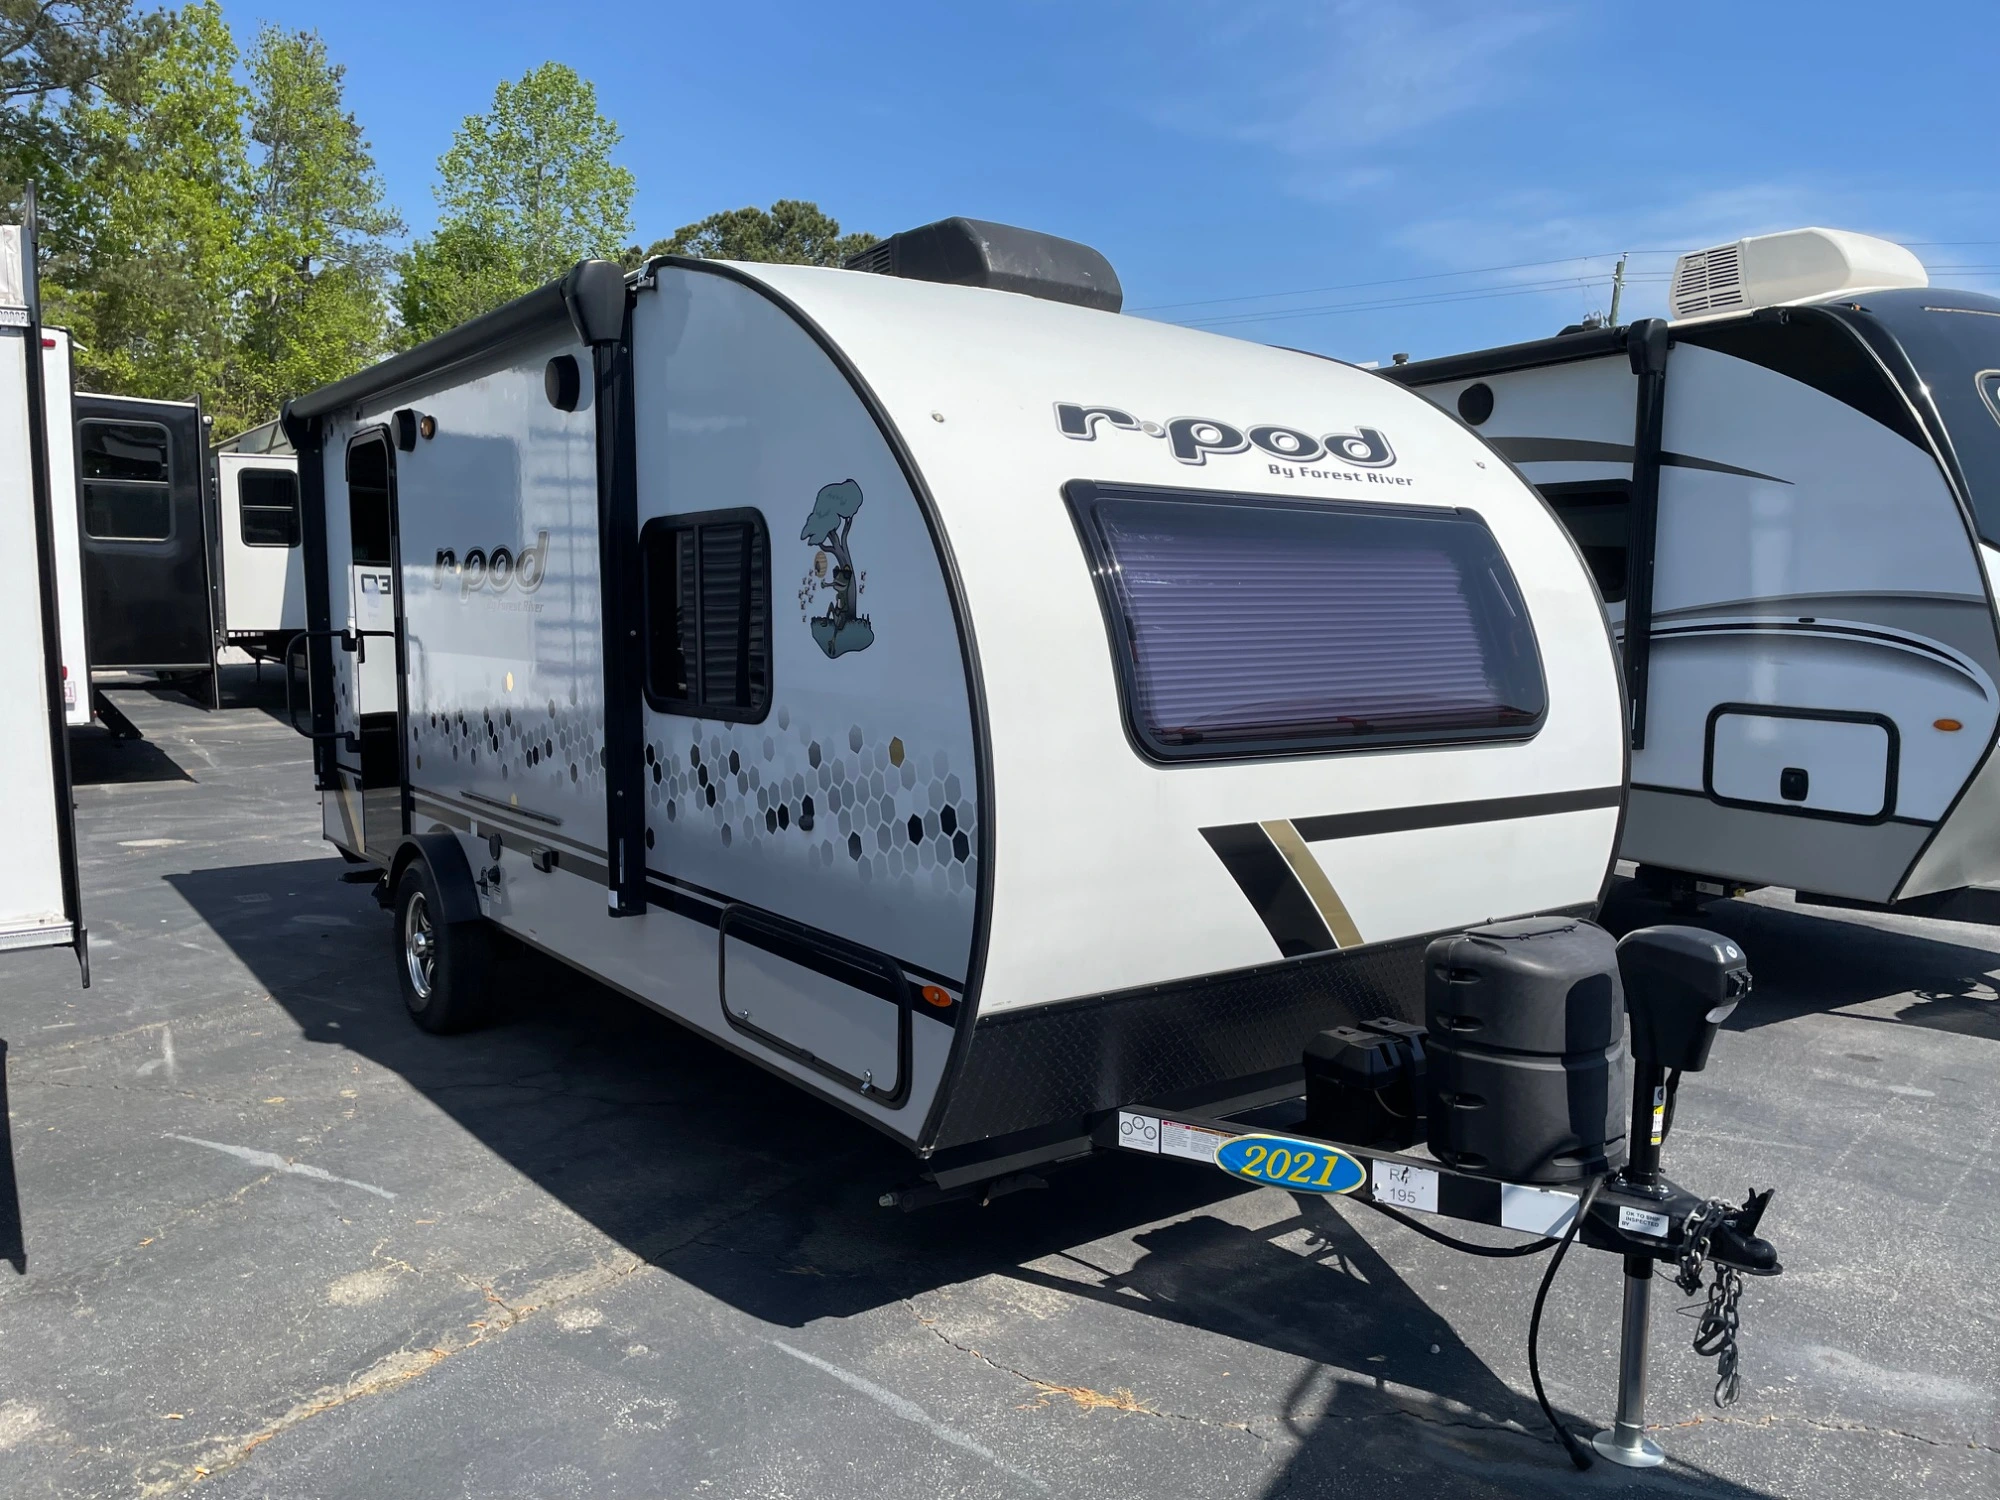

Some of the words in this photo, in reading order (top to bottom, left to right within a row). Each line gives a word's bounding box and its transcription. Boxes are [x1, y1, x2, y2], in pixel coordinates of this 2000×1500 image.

[1268, 464, 1295, 479] By
[1299, 466, 1363, 482] Forest
[1367, 472, 1413, 486] River
[523, 600, 545, 613] River
[1240, 1146, 1338, 1187] 2021
[1390, 1187, 1416, 1204] 195
[1626, 1217, 1659, 1227] INSPECTED
